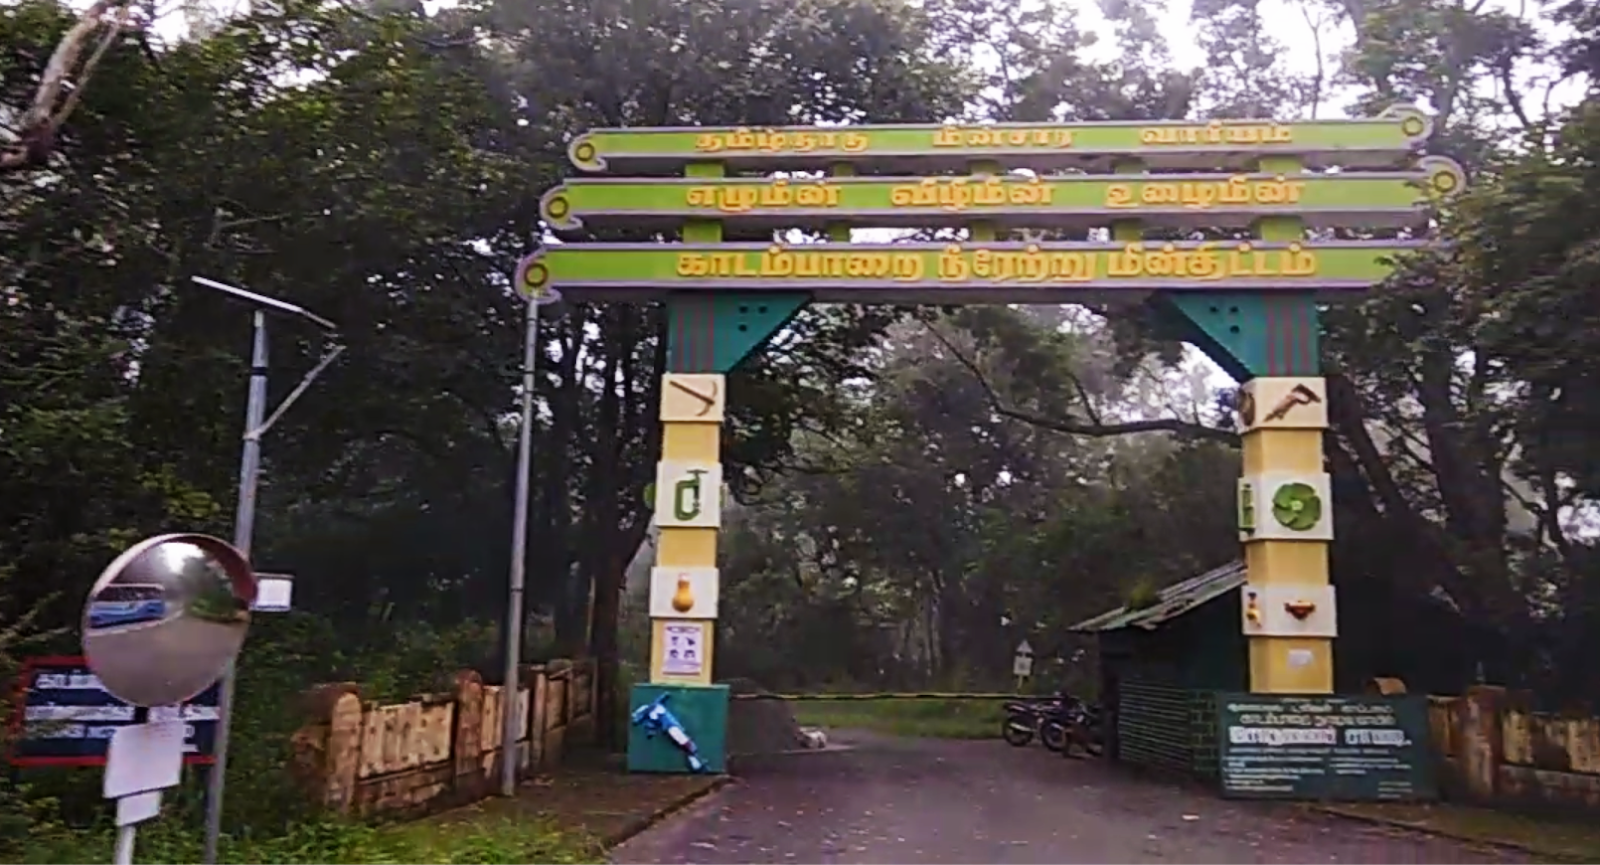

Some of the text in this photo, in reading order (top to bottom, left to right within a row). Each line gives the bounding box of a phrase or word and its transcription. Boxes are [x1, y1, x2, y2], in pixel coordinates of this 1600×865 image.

[932, 126, 1073, 148] மின்சார
[1141, 120, 1292, 144] வாரியம்
[686, 179, 842, 211] எழுமின்
[891, 176, 1057, 211] விழிமின்
[676, 245, 924, 282] காடம்பாறை
[938, 243, 1095, 282] நீரேற்று
